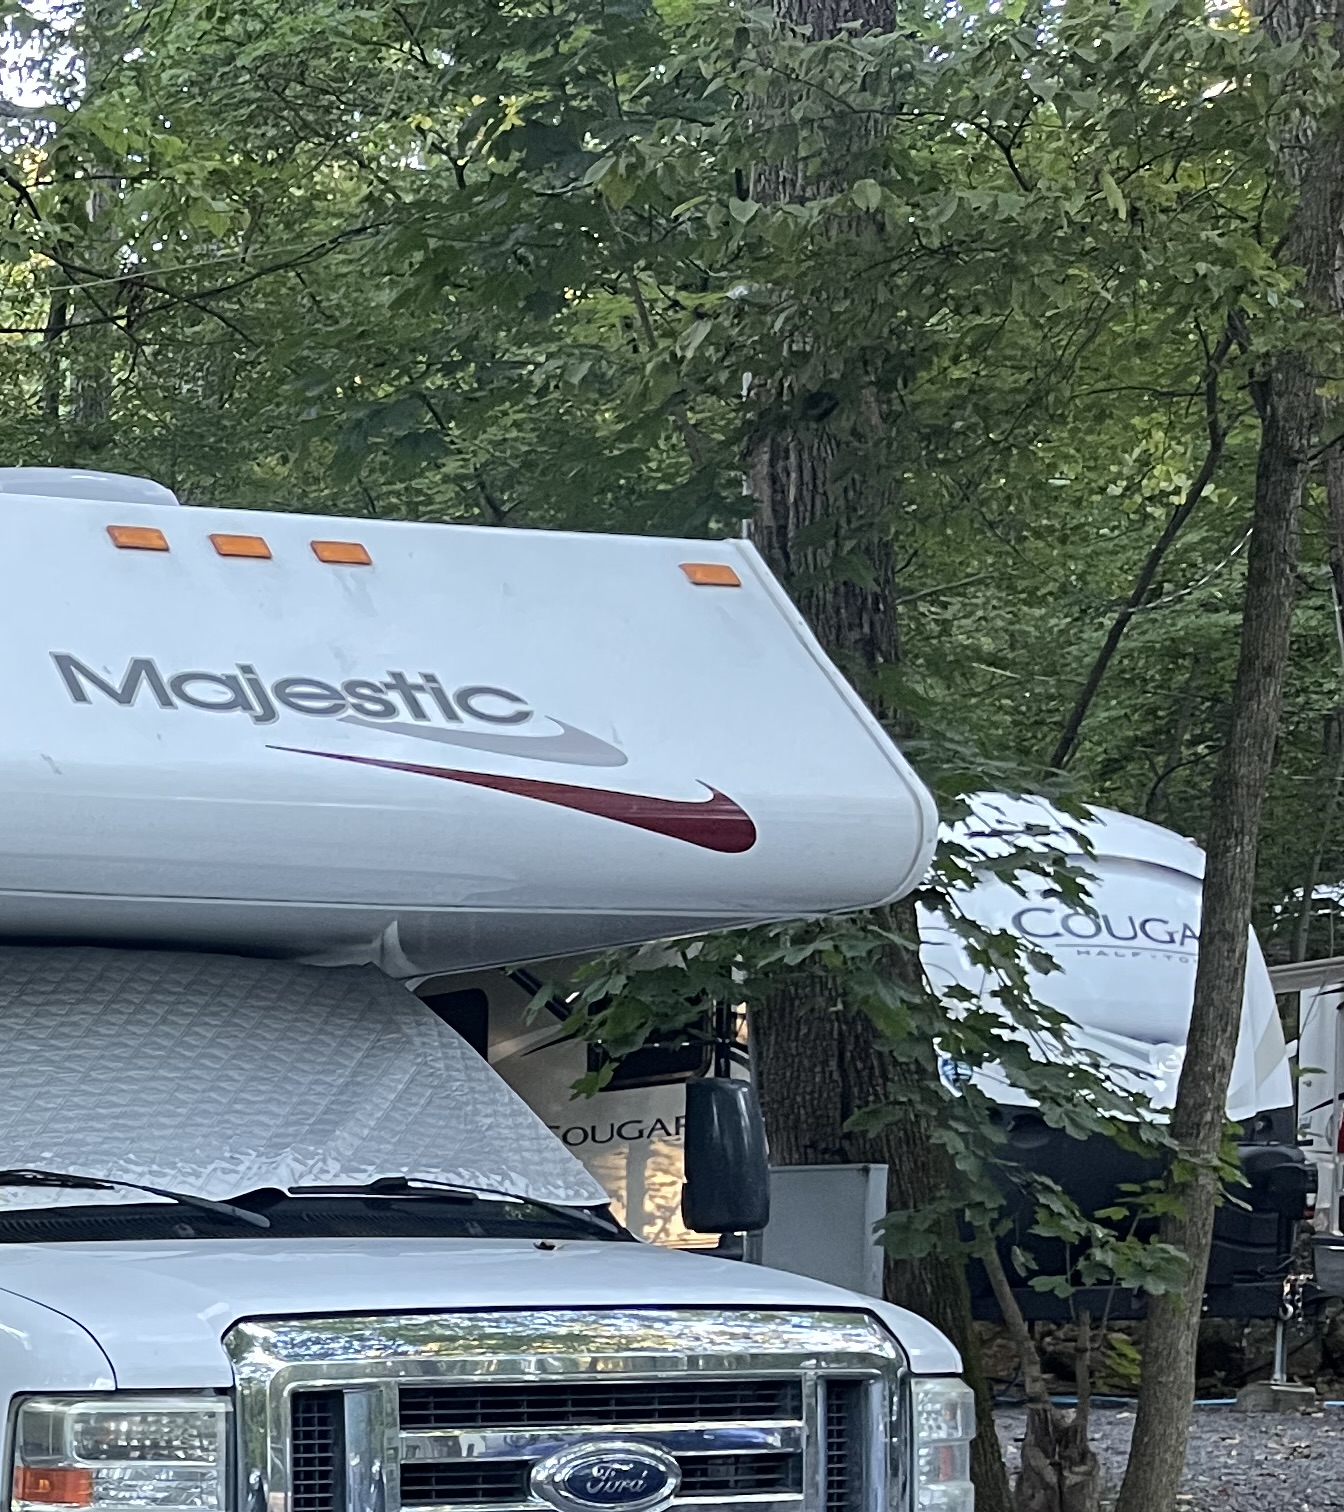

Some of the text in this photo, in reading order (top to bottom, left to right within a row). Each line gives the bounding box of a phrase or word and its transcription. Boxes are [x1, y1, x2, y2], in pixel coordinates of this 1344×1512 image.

[49, 650, 534, 726] Majestic
[1011, 906, 1200, 948] COUGA
[1076, 949, 1198, 965] HALF-TO
[547, 1114, 686, 1147] OUGAR
[586, 1463, 648, 1494] Ford
